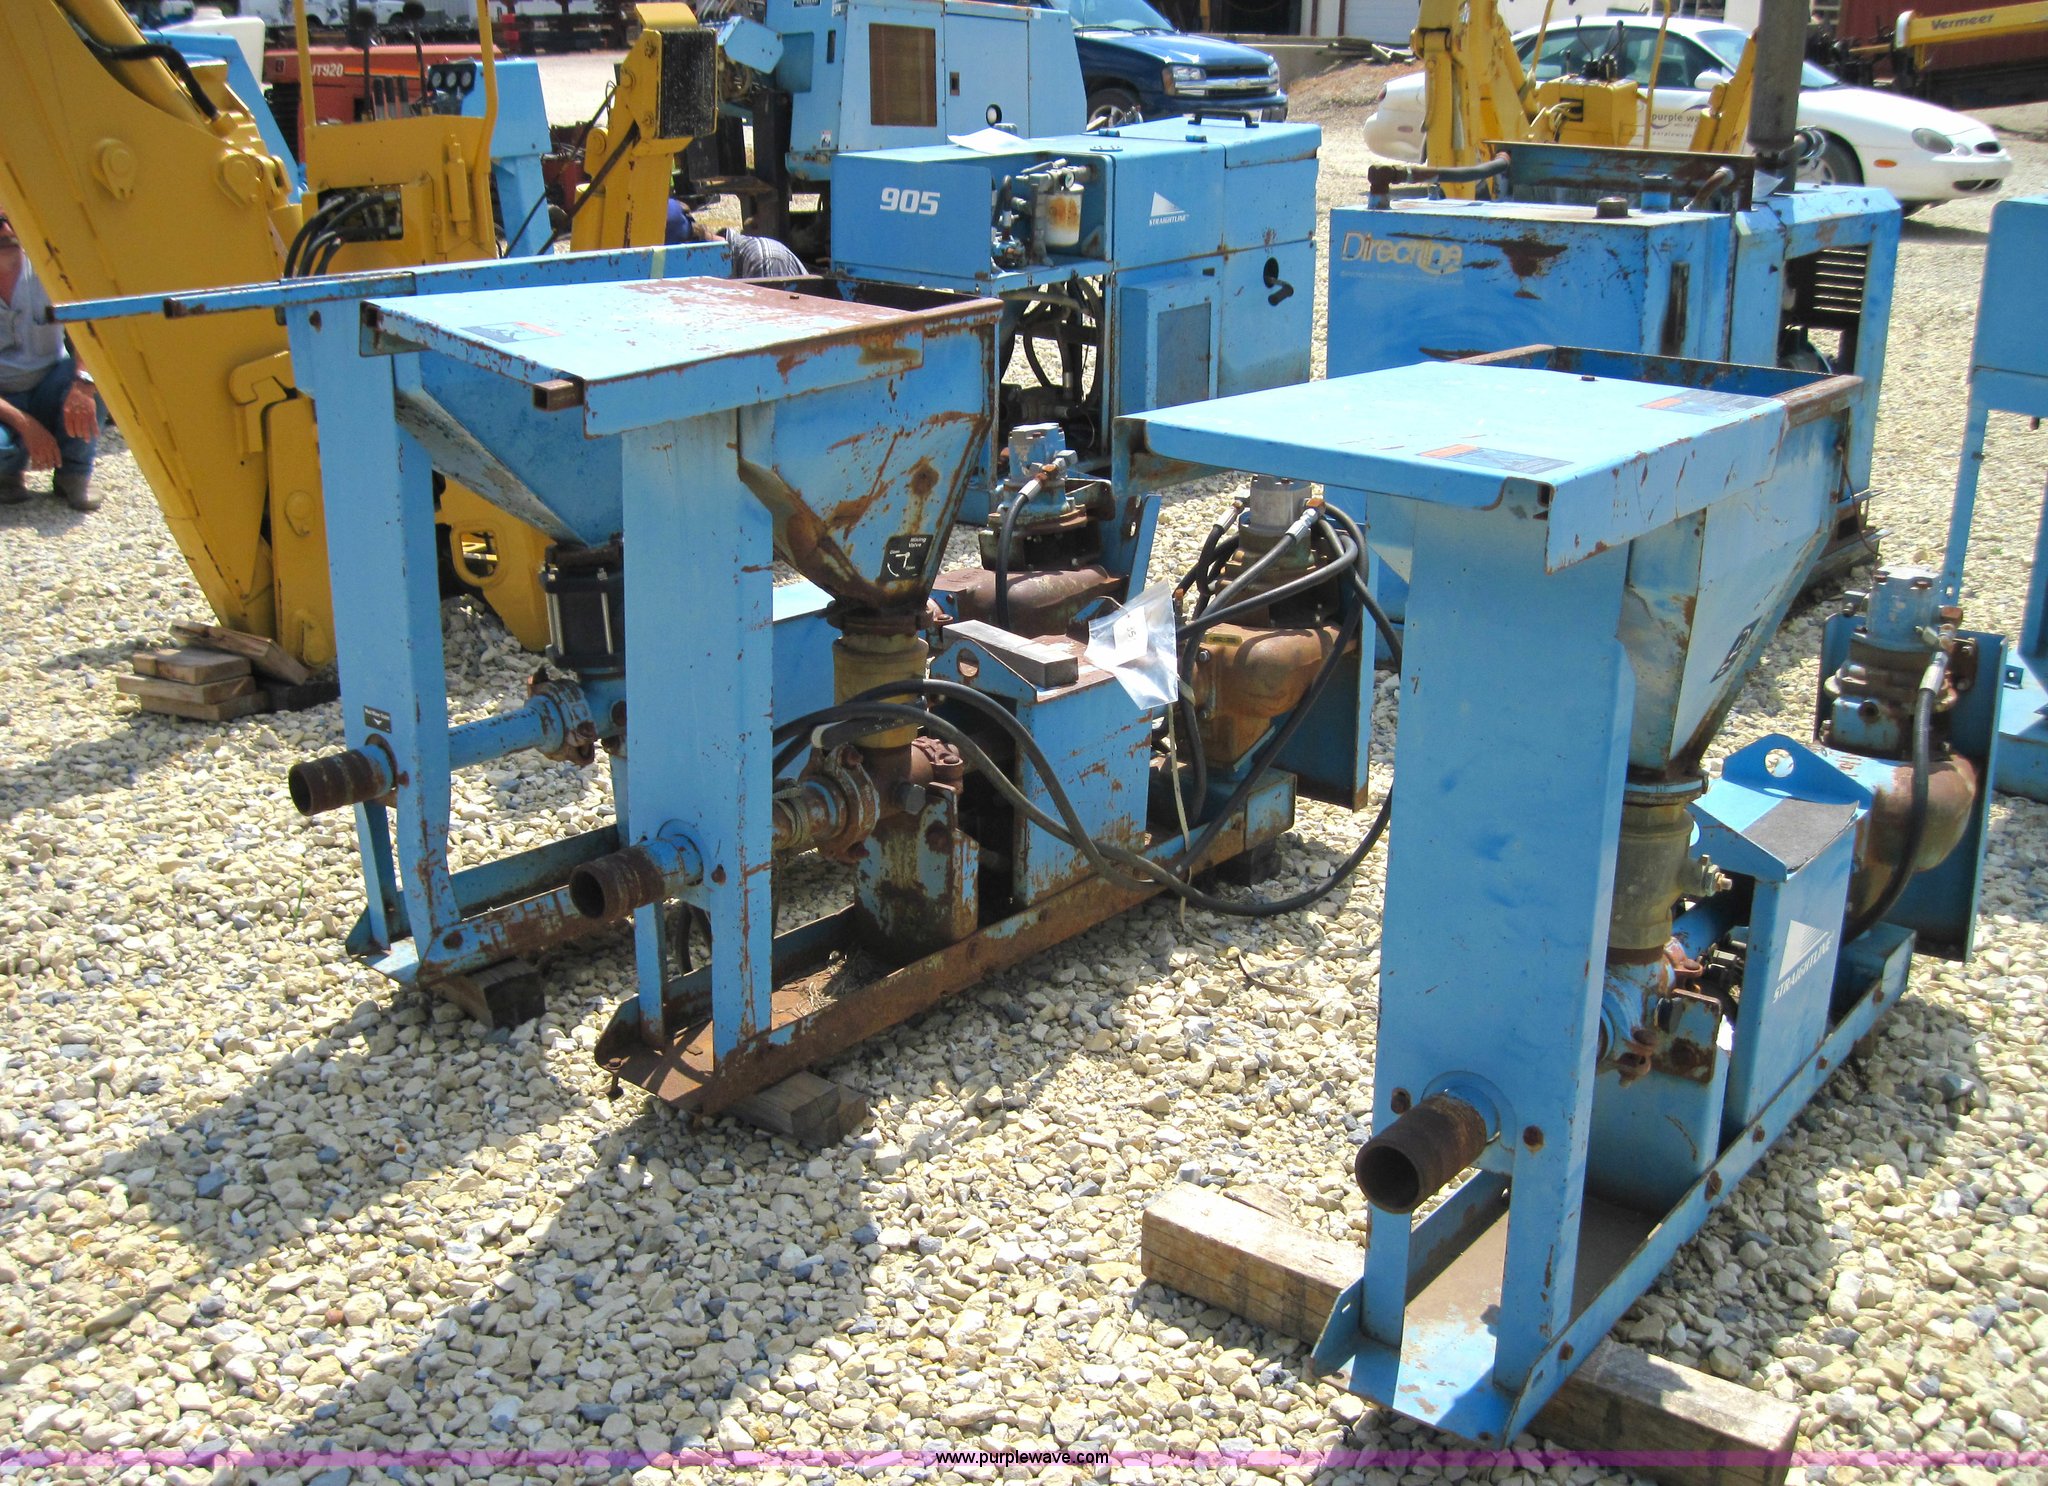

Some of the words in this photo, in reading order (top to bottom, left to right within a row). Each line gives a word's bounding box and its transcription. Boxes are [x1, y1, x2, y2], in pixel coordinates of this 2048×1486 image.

[1931, 14, 1994, 31] Vermeer
[1652, 113, 1683, 123] purple
[880, 187, 940, 216] 905
[1772, 933, 1834, 1004] STRAIGHTLINE
